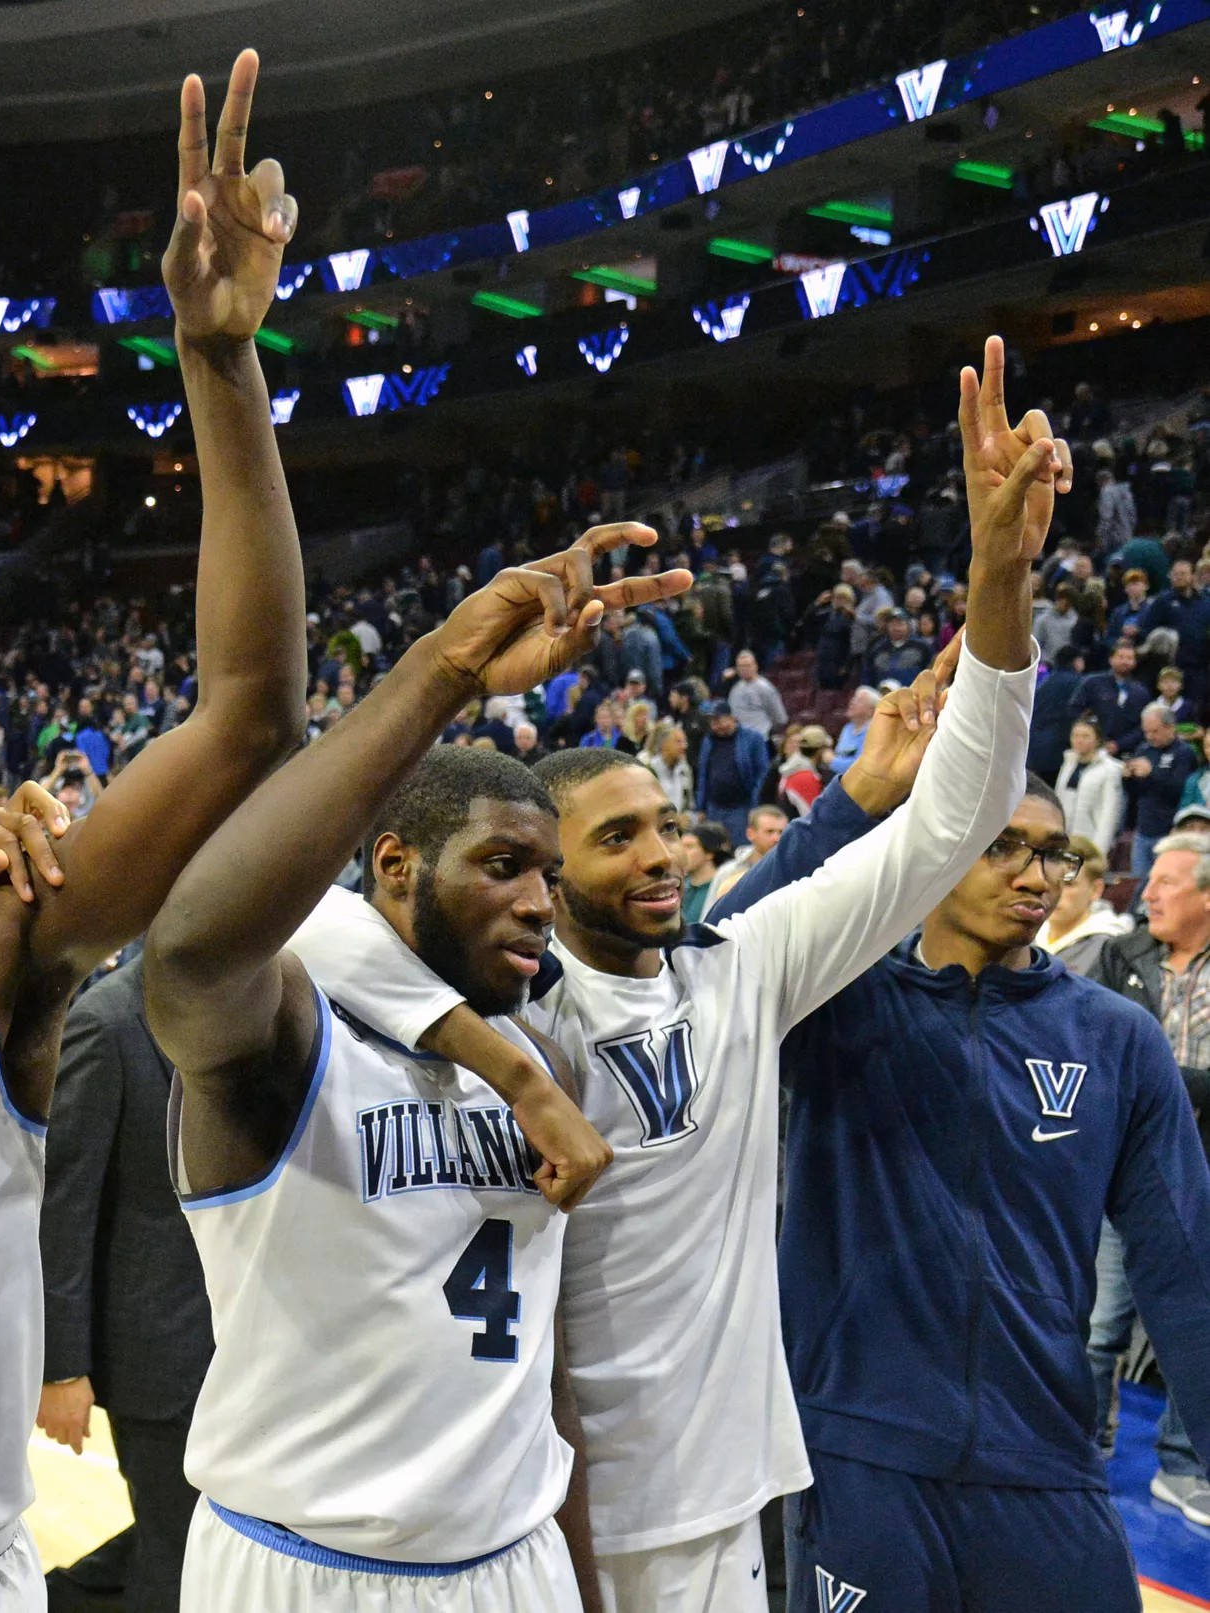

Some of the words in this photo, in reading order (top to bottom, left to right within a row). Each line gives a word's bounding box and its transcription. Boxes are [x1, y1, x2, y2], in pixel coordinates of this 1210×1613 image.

[895, 59, 947, 122] V
[1039, 191, 1099, 257] V
[595, 1019, 699, 1148] V
[1025, 1058, 1088, 1118] V
[442, 1217, 521, 1363] 4
[815, 1564, 868, 1613] V
